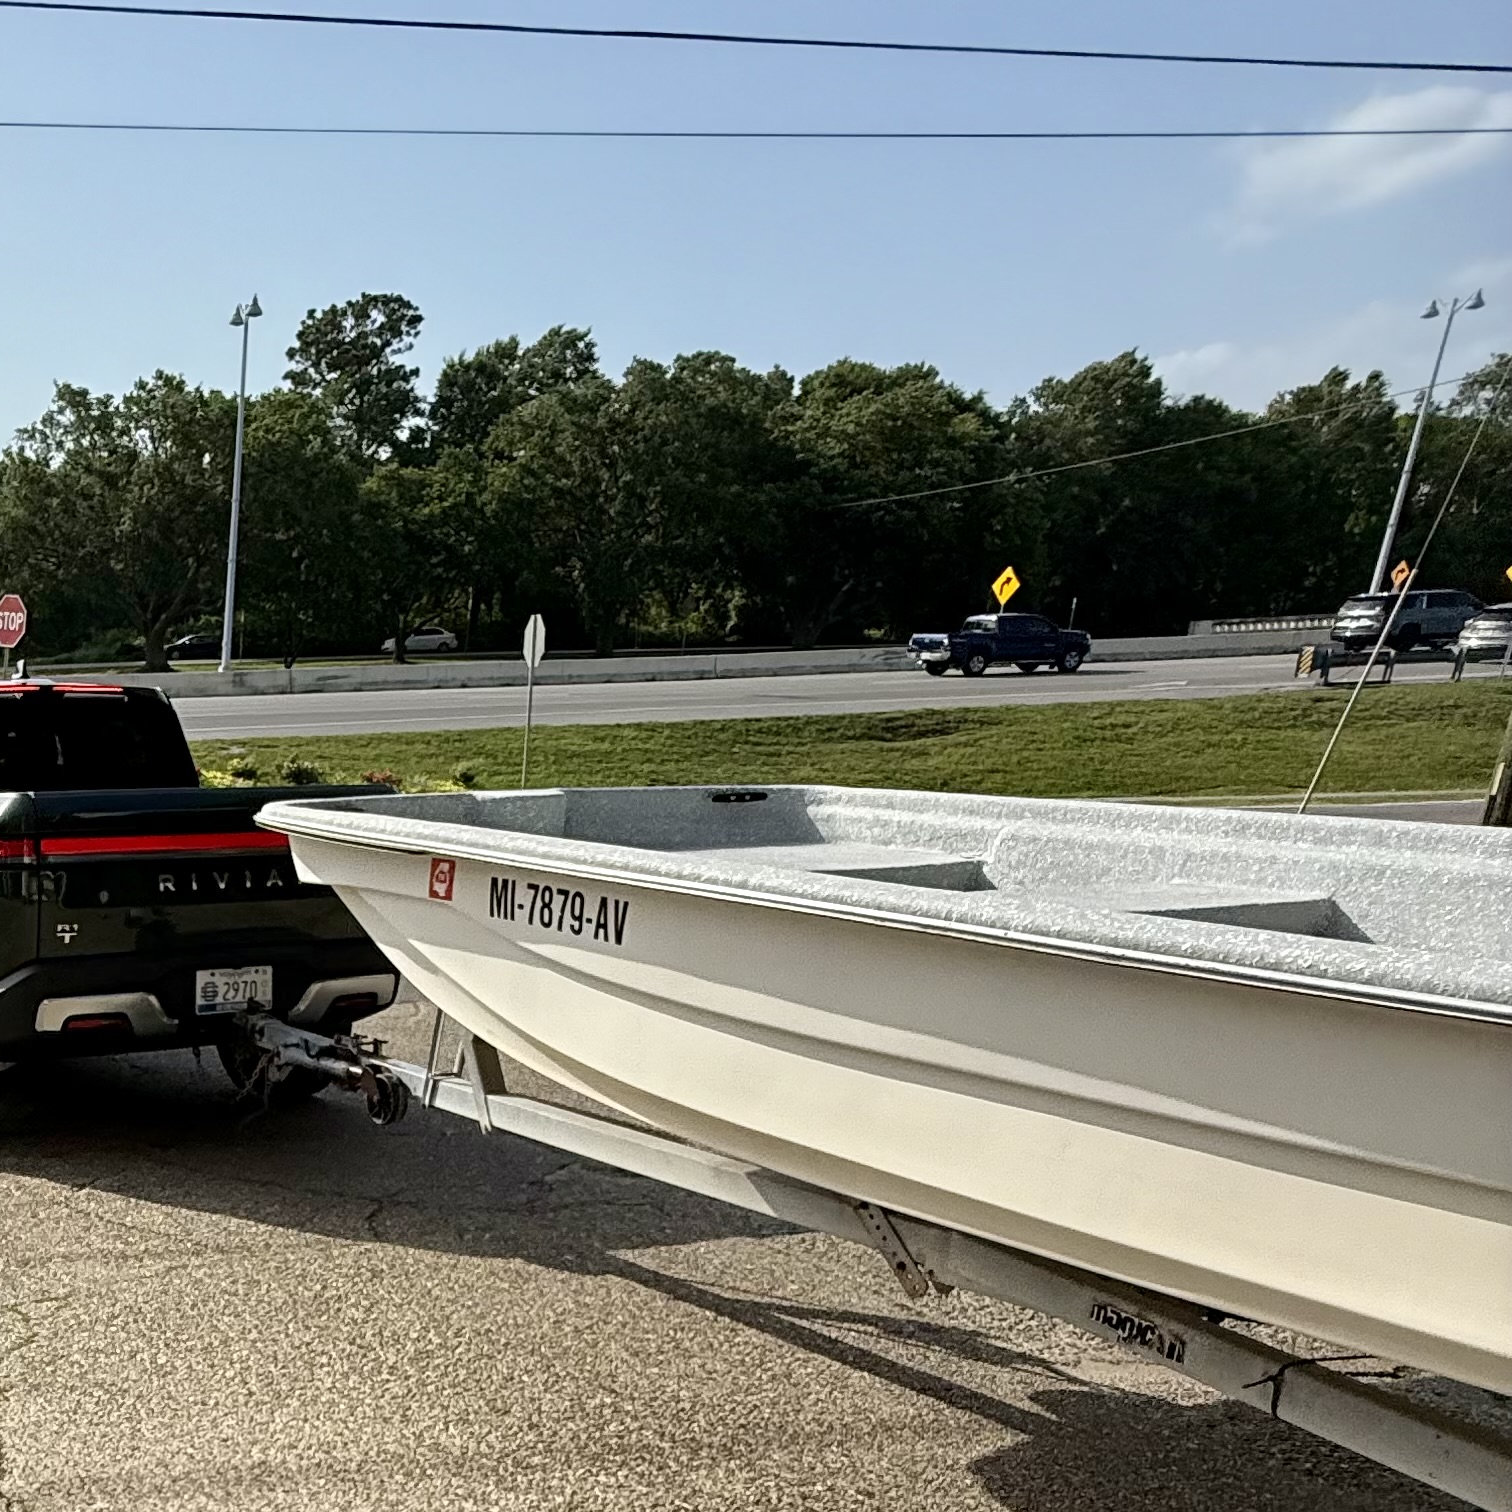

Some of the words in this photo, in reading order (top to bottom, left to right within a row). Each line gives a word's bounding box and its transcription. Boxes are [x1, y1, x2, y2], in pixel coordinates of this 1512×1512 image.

[157, 868, 284, 892] RIVIA
[489, 876, 629, 946] MI-7879-AV
[222, 980, 258, 1001] 2970
